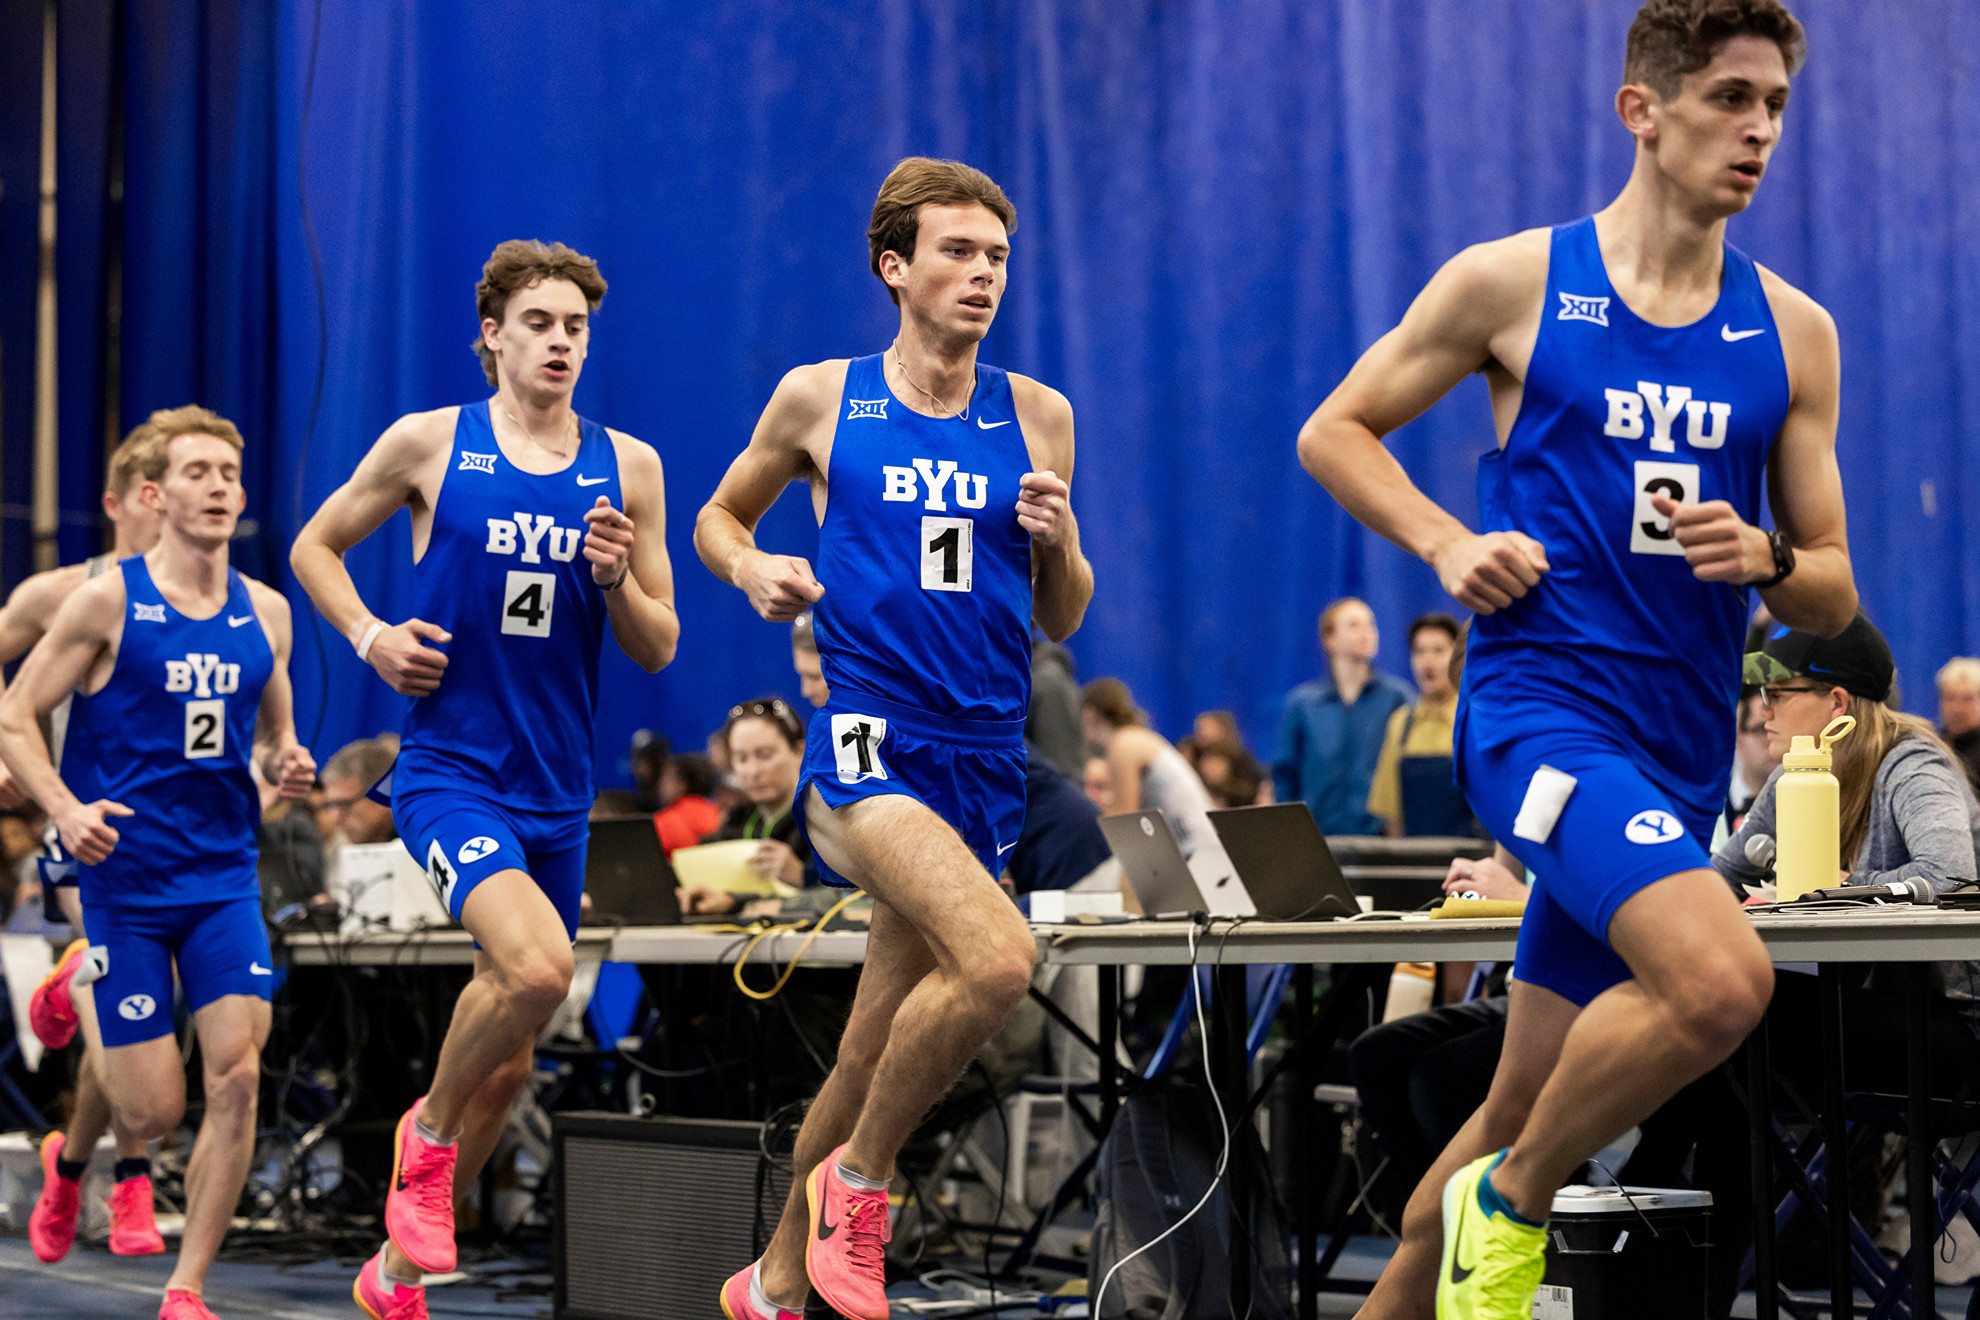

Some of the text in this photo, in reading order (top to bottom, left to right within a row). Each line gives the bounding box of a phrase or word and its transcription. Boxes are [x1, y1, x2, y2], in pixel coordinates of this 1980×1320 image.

[1603, 380, 1731, 453] BYU
[882, 458, 988, 511] BYU
[1640, 477, 1685, 540] 3
[486, 511, 581, 564] BYU
[929, 527, 960, 584] 1
[507, 583, 545, 627] 4
[164, 653, 241, 698] BYU
[190, 713, 217, 751] 2
[841, 721, 873, 773] 1
[431, 855, 449, 897] 4
